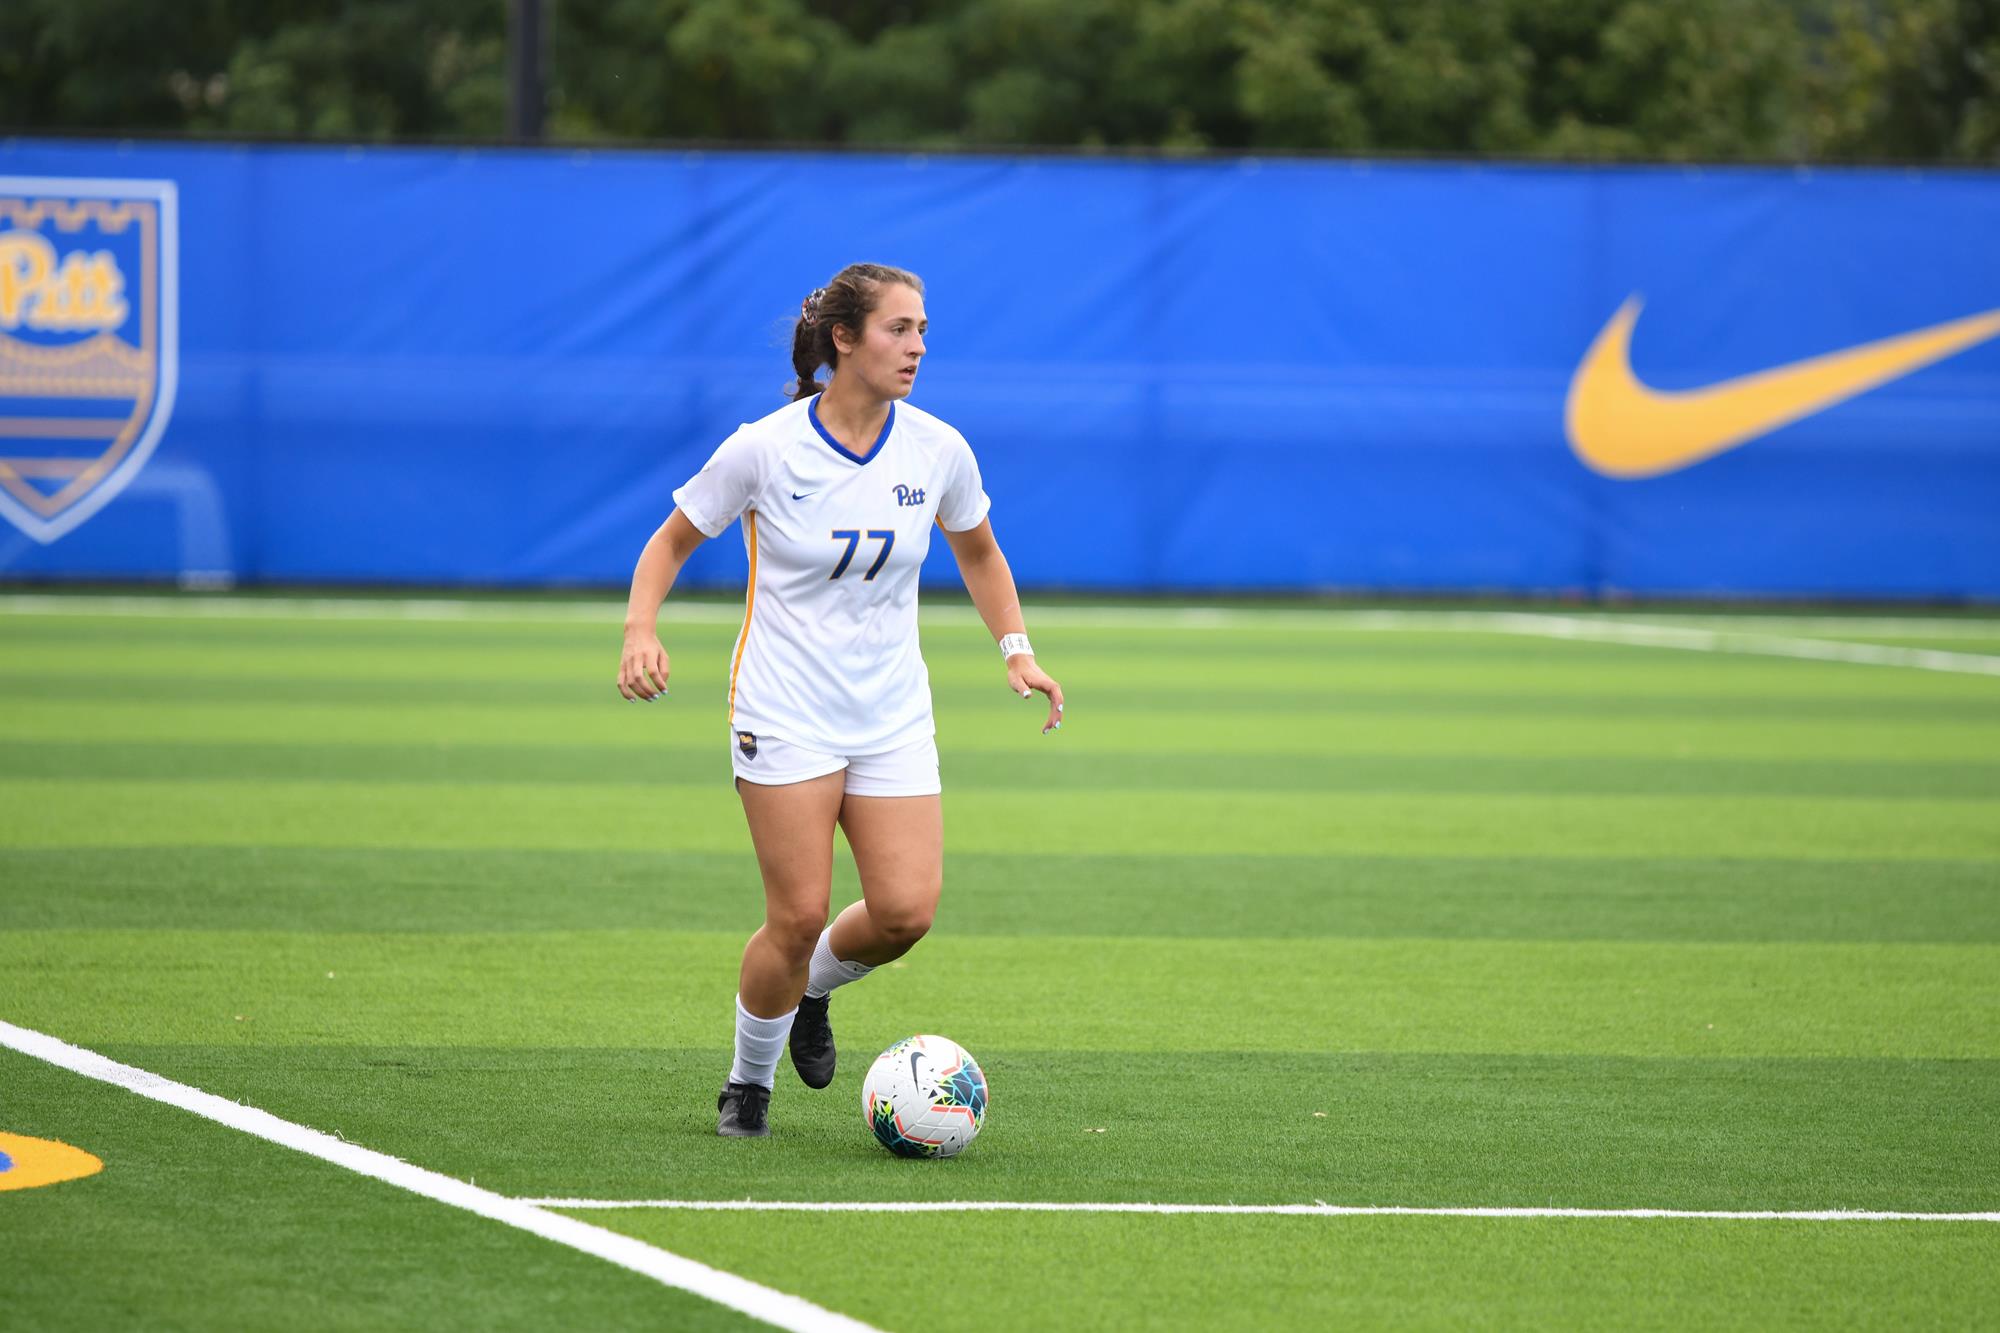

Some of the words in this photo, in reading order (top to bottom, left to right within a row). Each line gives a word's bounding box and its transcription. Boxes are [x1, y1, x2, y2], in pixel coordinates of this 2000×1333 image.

[0, 231, 128, 331] Pitt
[892, 484, 925, 506] Pitt
[828, 530, 895, 581] 77
